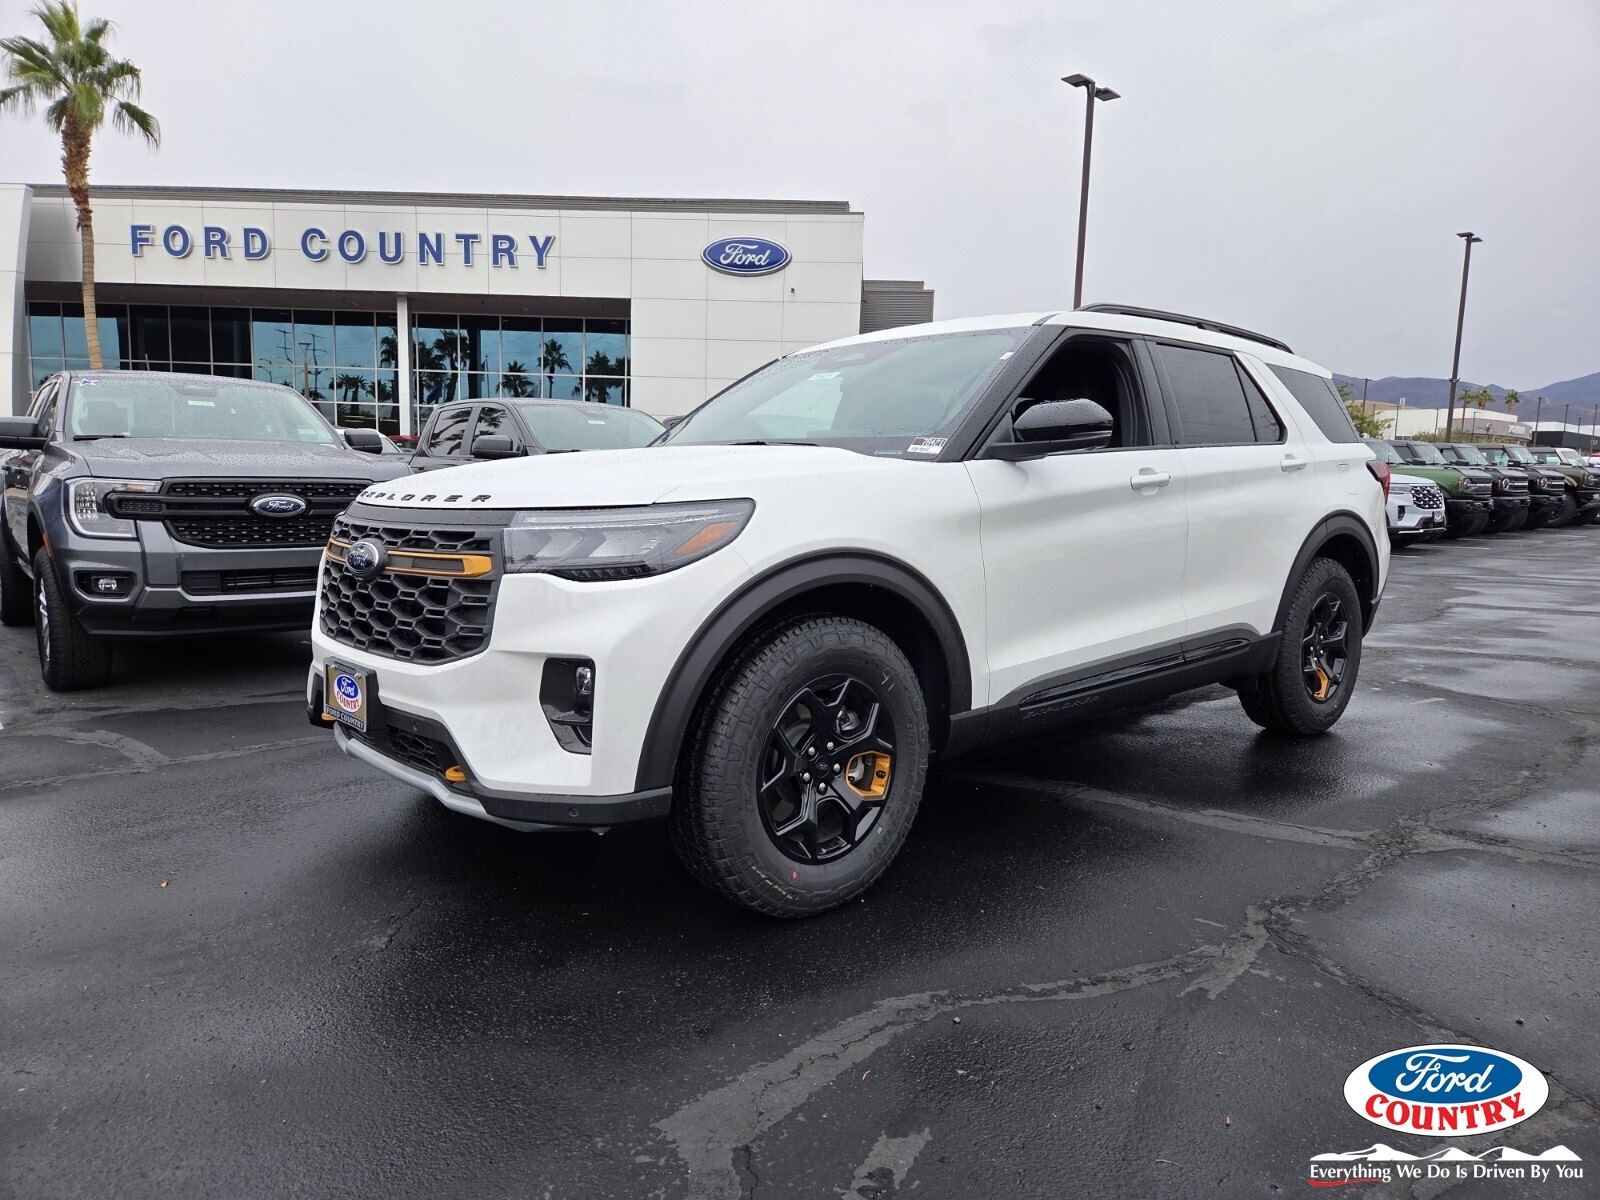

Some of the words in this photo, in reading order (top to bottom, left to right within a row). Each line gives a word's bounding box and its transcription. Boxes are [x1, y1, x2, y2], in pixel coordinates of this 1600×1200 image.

[130, 223, 271, 261] FORD
[300, 226, 556, 269] COUNTRY
[720, 243, 771, 265] Ford
[266, 501, 294, 511] Ford
[340, 677, 355, 696] Ford
[336, 690, 360, 709] COUNTRY
[326, 706, 340, 717] FORD
[340, 712, 364, 729] COUNTRY
